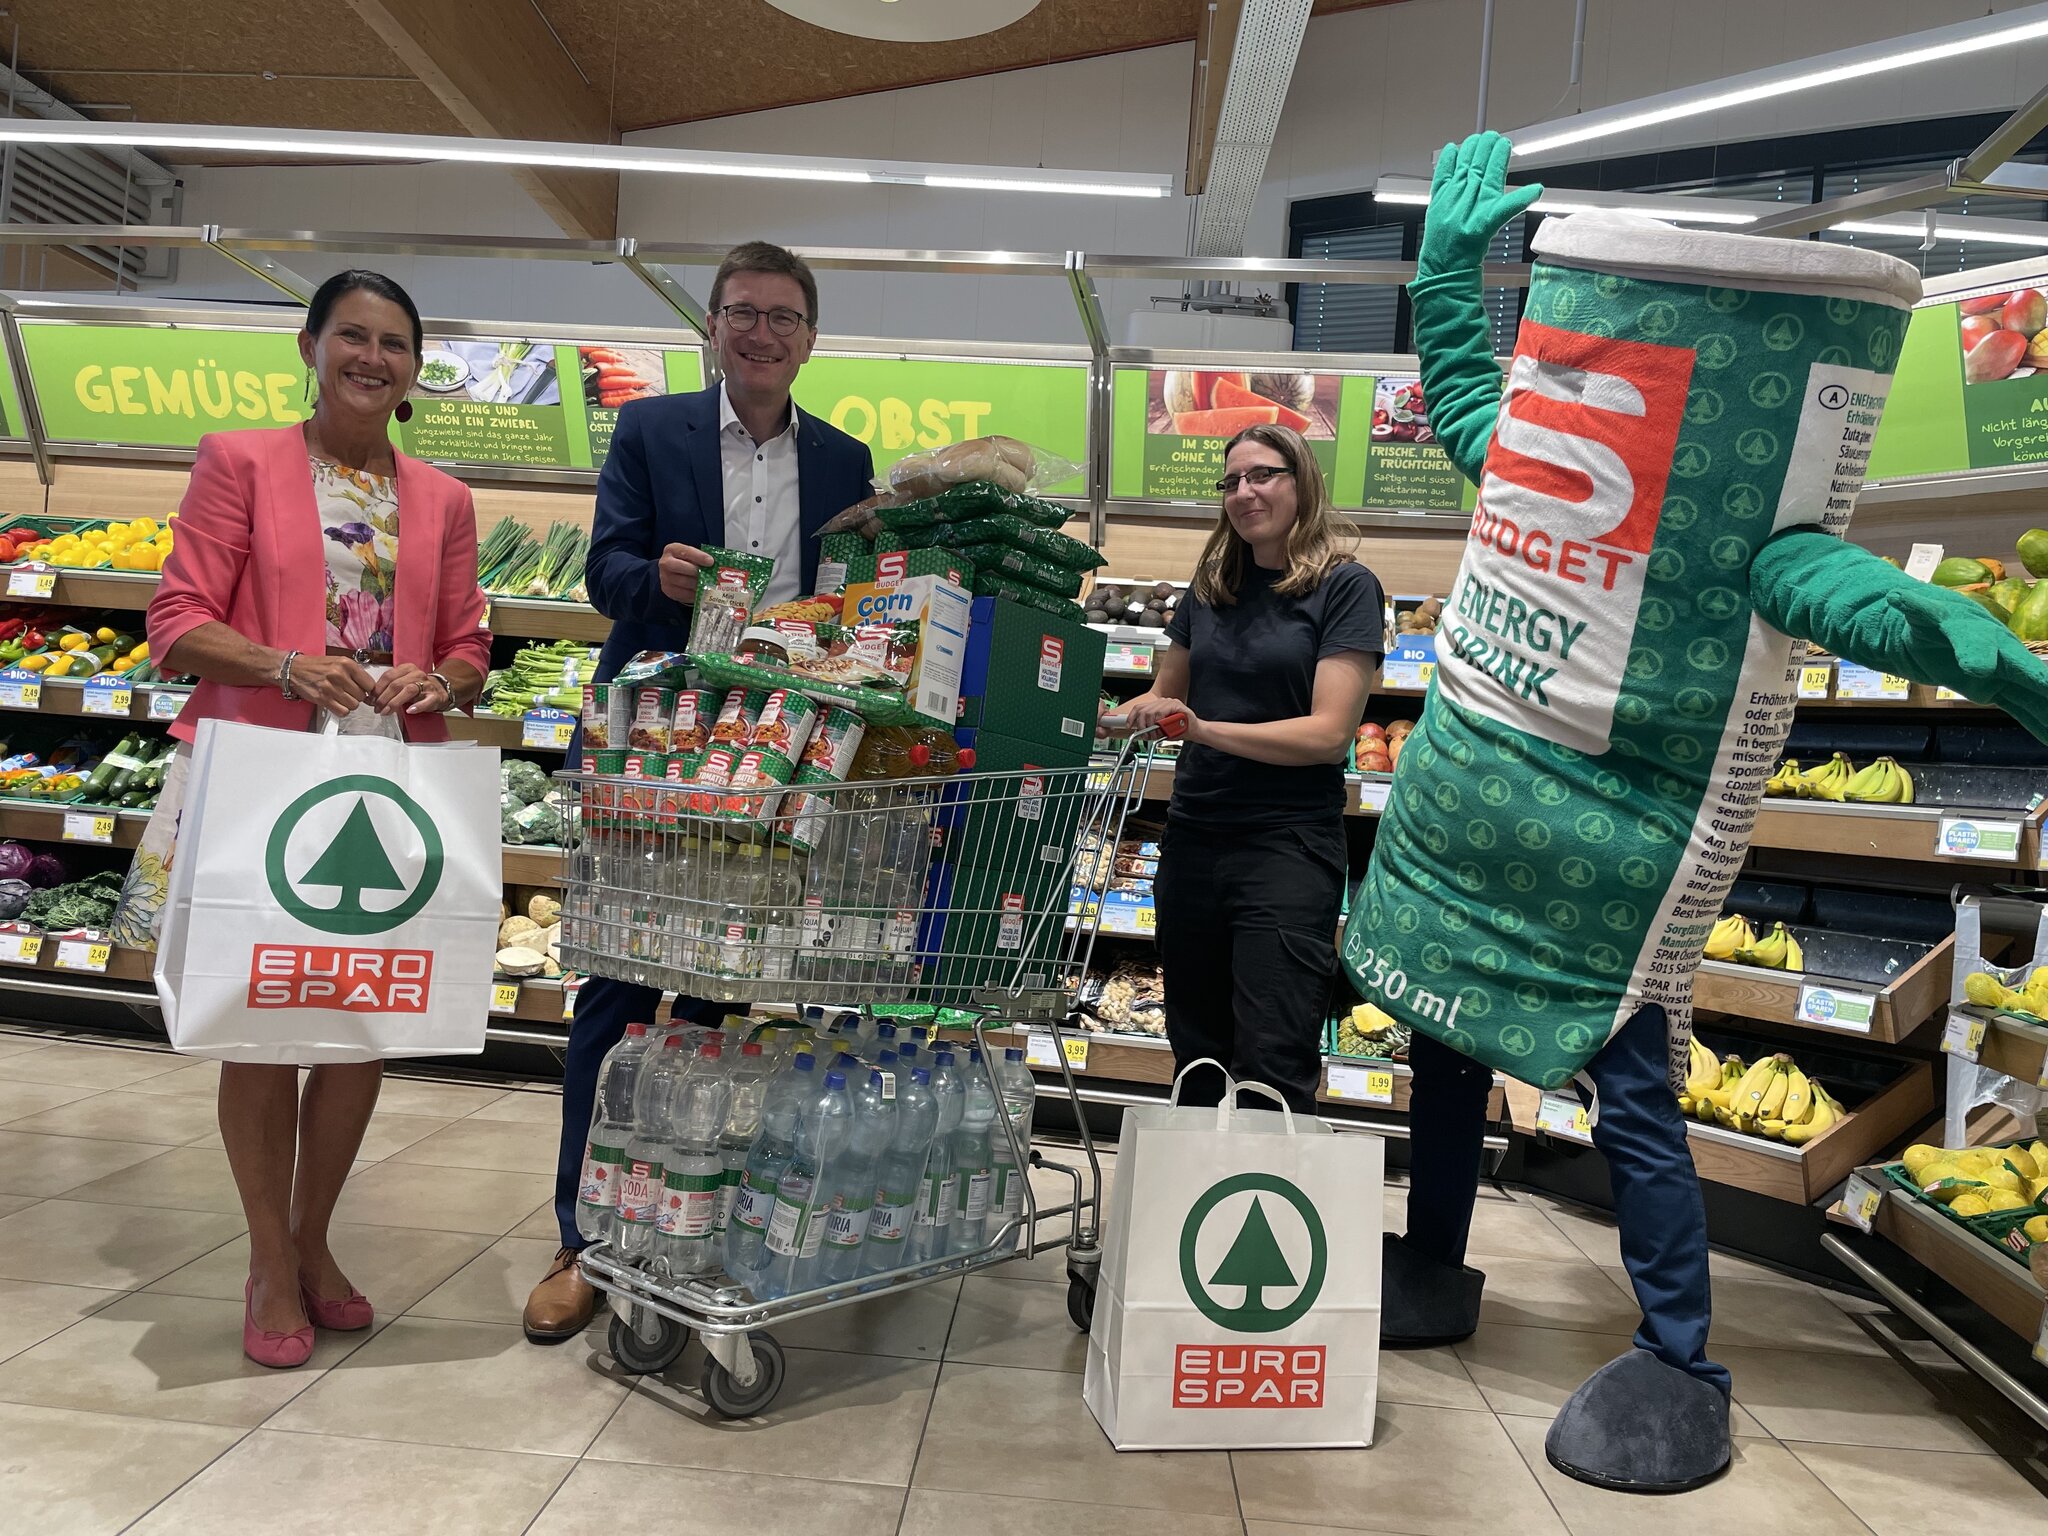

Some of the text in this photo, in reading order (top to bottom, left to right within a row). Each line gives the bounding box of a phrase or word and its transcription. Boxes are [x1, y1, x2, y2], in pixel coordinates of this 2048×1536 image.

[75, 359, 302, 422] GEMÜSE
[440, 403, 519, 416] SO JUNG UND
[592, 411, 608, 420] DIE
[425, 414, 538, 430] SCHON EIN ZWIEBEL
[830, 395, 992, 450] OBST
[1981, 417, 2048, 432] Nicht läng
[413, 426, 554, 442] Jungzwiebel sind das ganze Jahr
[418, 437, 553, 453] über erhältlich und bringen eine
[1182, 439, 1196, 450] IM
[415, 448, 458, 458] besondere
[492, 452, 499, 460] in
[502, 453, 521, 461] Ihre
[1172, 452, 1205, 463] OHNE
[1371, 446, 1418, 458] FRISCHE,
[1150, 464, 1217, 474] Erfrischender
[1380, 457, 1452, 471] FRÜCHTCHEN
[1374, 473, 1407, 484] Saftige
[1410, 475, 1426, 483] und
[1150, 486, 1187, 496] besteht
[1190, 487, 1198, 496] in
[1380, 485, 1446, 496] Nektarinen aus
[1367, 496, 1457, 508] dem sonnigen Süden!
[1471, 501, 1633, 592] BUDGET
[39, 579, 53, 588] 1,49
[875, 580, 904, 589] BUDGET
[1458, 573, 1588, 660] ENERGY
[1403, 650, 1425, 660] BIO
[1450, 626, 1559, 706] DRINK
[9, 670, 28, 680] BIO
[1806, 672, 1826, 684] 0,79
[100, 676, 118, 687] BIO
[24, 688, 38, 698] 2,49
[114, 695, 129, 704] 2,99
[540, 709, 560, 719] BIO
[1745, 708, 1772, 720] oder
[1736, 736, 1748, 748] in
[97, 821, 112, 831] 2,49
[1948, 830, 1978, 838] PLASTIK
[1705, 836, 1726, 850] Am
[1948, 836, 1976, 845] SPAREN
[1687, 880, 1710, 891] and
[1672, 906, 1694, 918] Best
[23, 941, 38, 952] 1,99
[91, 949, 107, 959] 2,49
[1653, 949, 1680, 960] SPAR
[258, 950, 427, 979] EURO
[1649, 961, 1674, 974] 5015
[1355, 948, 1462, 1030] 250 ml
[1643, 978, 1670, 992] SPAR
[255, 980, 423, 1008] SPAR
[499, 990, 515, 1000] 2,19
[1807, 1003, 1834, 1014] SPAREN
[1067, 1045, 1085, 1055] 3,99
[1371, 1077, 1389, 1088] 1,99
[623, 1180, 648, 1198] SODA
[1180, 1350, 1321, 1375] EURO
[1178, 1379, 1318, 1403] SPAR
